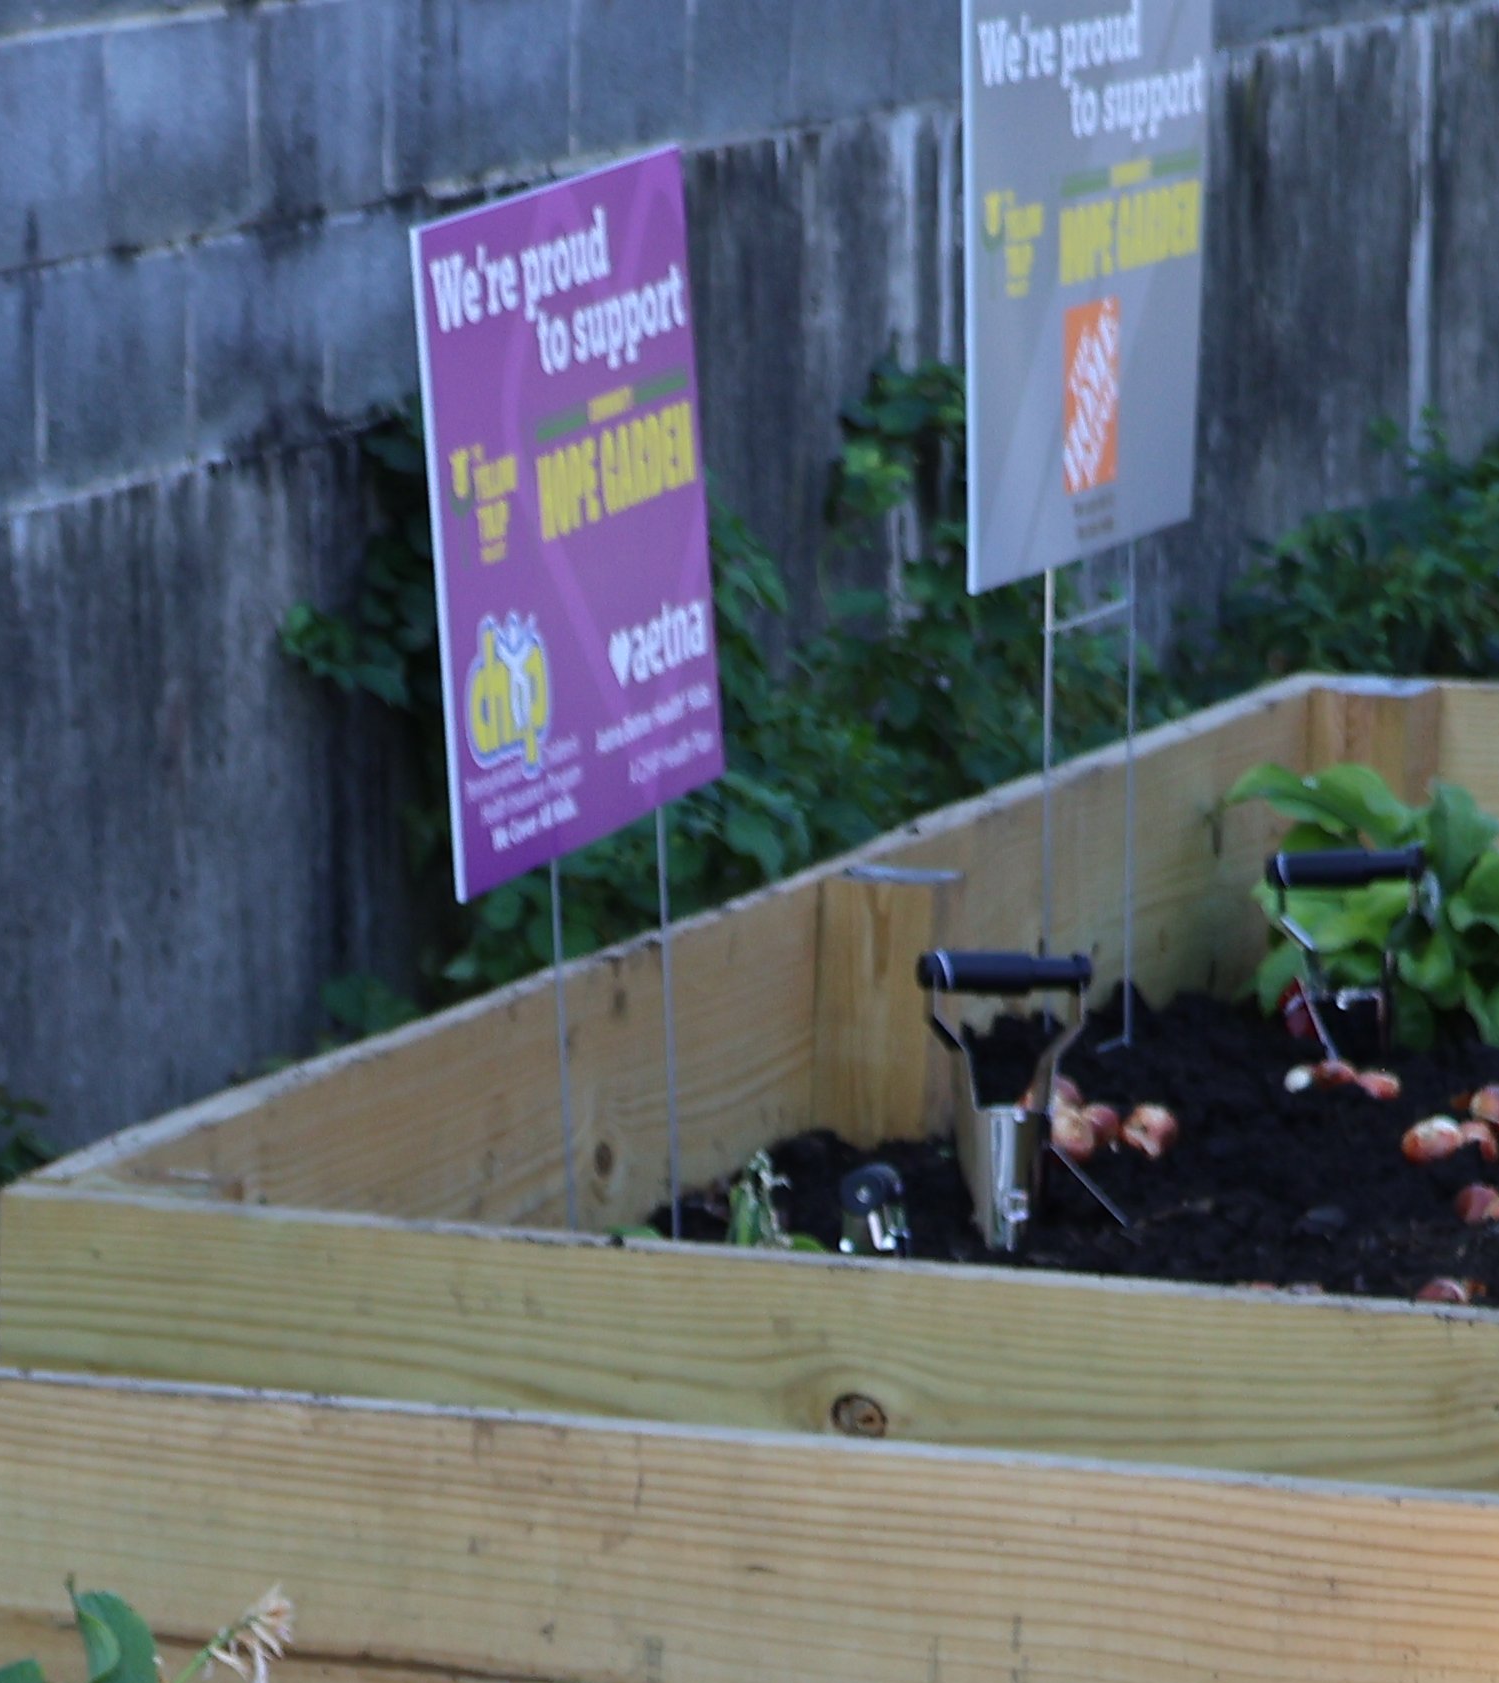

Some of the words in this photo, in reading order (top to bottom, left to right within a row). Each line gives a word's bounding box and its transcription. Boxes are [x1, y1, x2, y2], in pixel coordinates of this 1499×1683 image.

[978, 13, 1056, 88] We're
[1060, 0, 1138, 88] proud
[1069, 80, 1098, 139] to
[1102, 54, 1203, 142] support
[429, 244, 520, 334] We're
[520, 204, 610, 322] proud
[536, 310, 570, 375] to
[572, 263, 687, 370] support
[537, 437, 602, 541] HOPE
[602, 400, 697, 516] GARDEN
[631, 602, 708, 684] aetna
